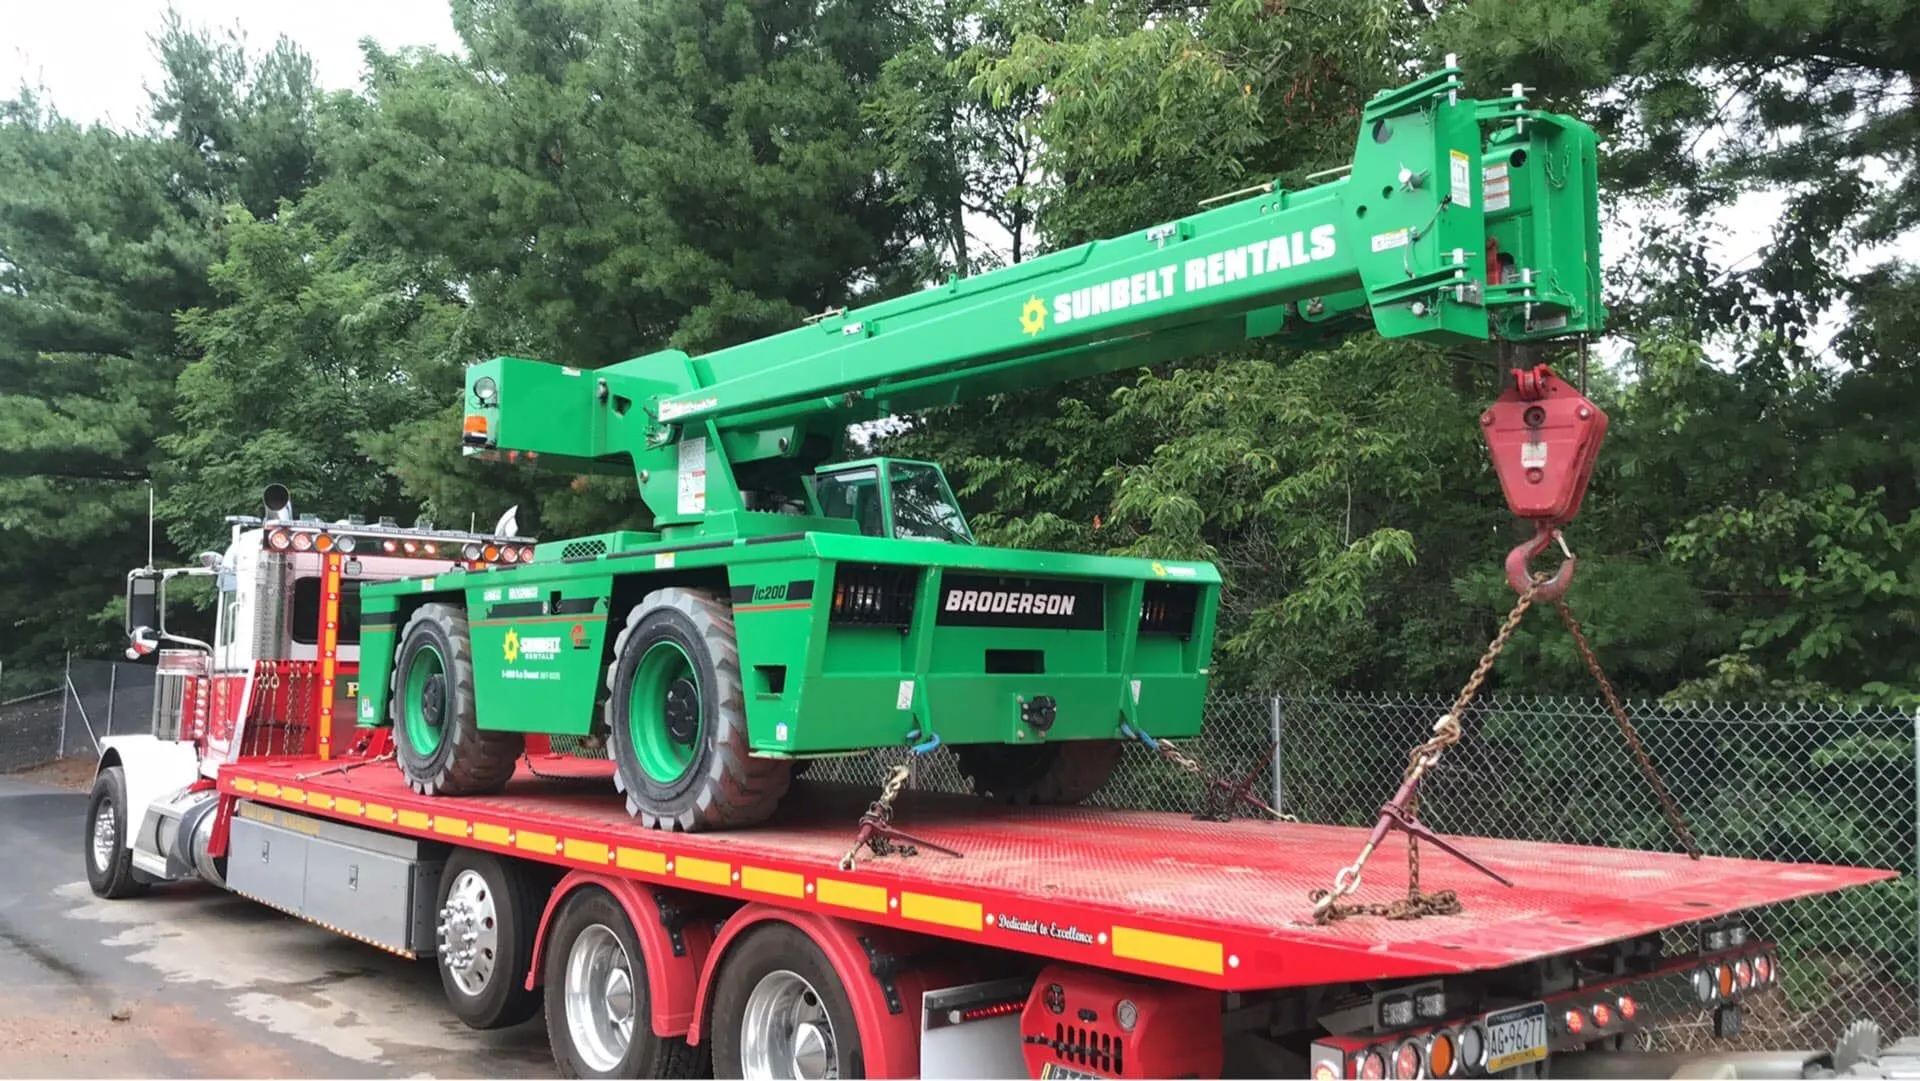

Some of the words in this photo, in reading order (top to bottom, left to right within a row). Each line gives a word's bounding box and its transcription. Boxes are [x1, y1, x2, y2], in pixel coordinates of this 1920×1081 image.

[1053, 264, 1178, 325] SUNBELT
[1184, 223, 1337, 293] RENTALS
[944, 589, 1075, 616] BRODERSON
[998, 914, 1038, 933] Dedicated
[1039, 922, 1048, 935] to
[1049, 921, 1094, 944] Excellence
